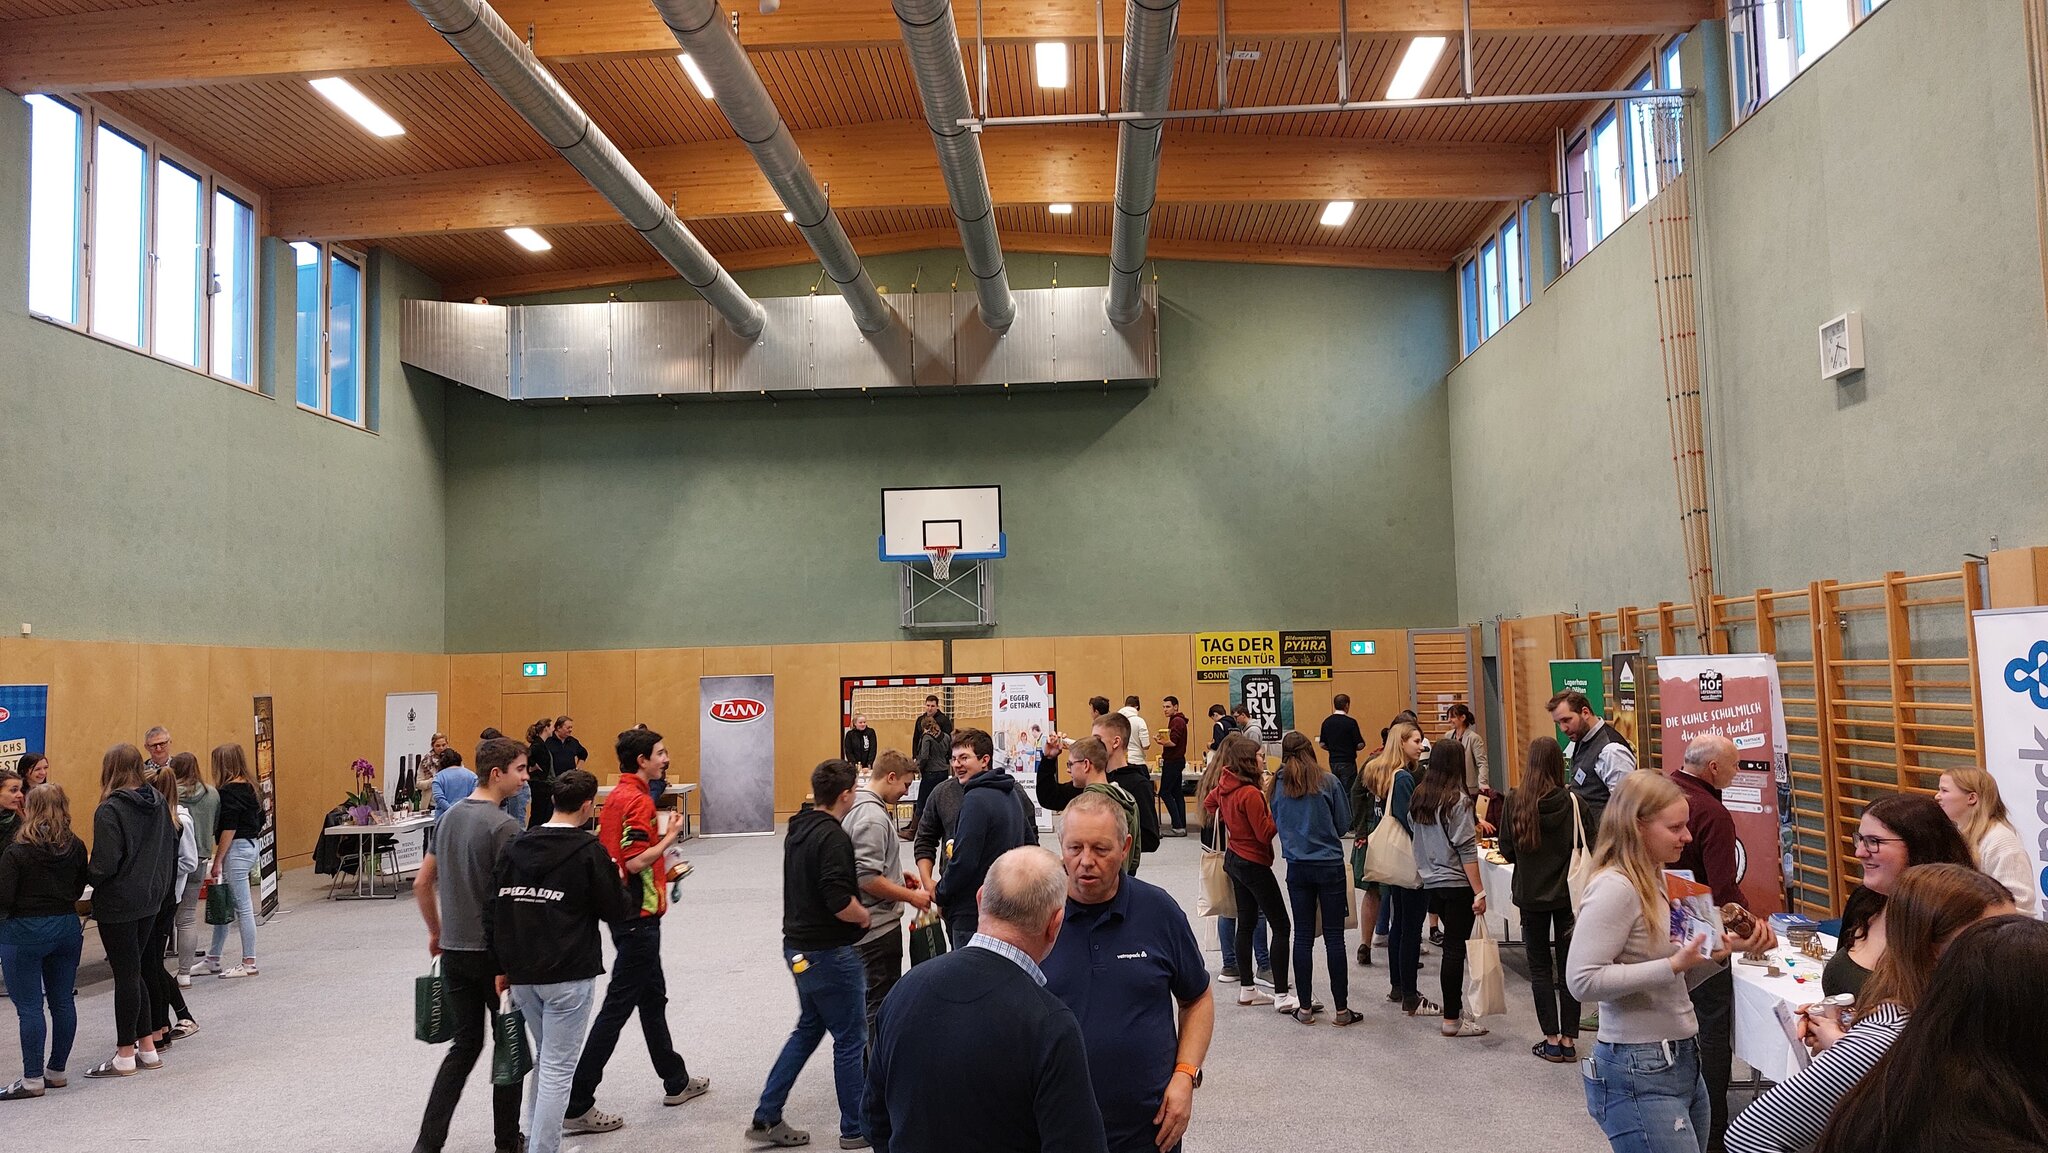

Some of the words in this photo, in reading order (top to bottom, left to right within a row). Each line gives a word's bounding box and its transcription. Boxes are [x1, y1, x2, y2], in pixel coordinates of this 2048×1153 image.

[1201, 637, 1234, 652] TAG
[1238, 638, 1274, 652] DER
[1284, 640, 1327, 651] PYHRA
[1201, 655, 1252, 665] OFFENEN
[1253, 652, 1275, 664] TÜR
[1564, 678, 1588, 687] Lagerhaus
[1700, 680, 1722, 690] HOF
[712, 700, 760, 717] TANN
[1010, 701, 1041, 709] GETRÄNKE
[1665, 716, 1680, 728] DIE
[1711, 702, 1762, 721] SCHULMILCH
[1726, 717, 1754, 735] denkt!
[429, 980, 442, 1037] WALDLAND
